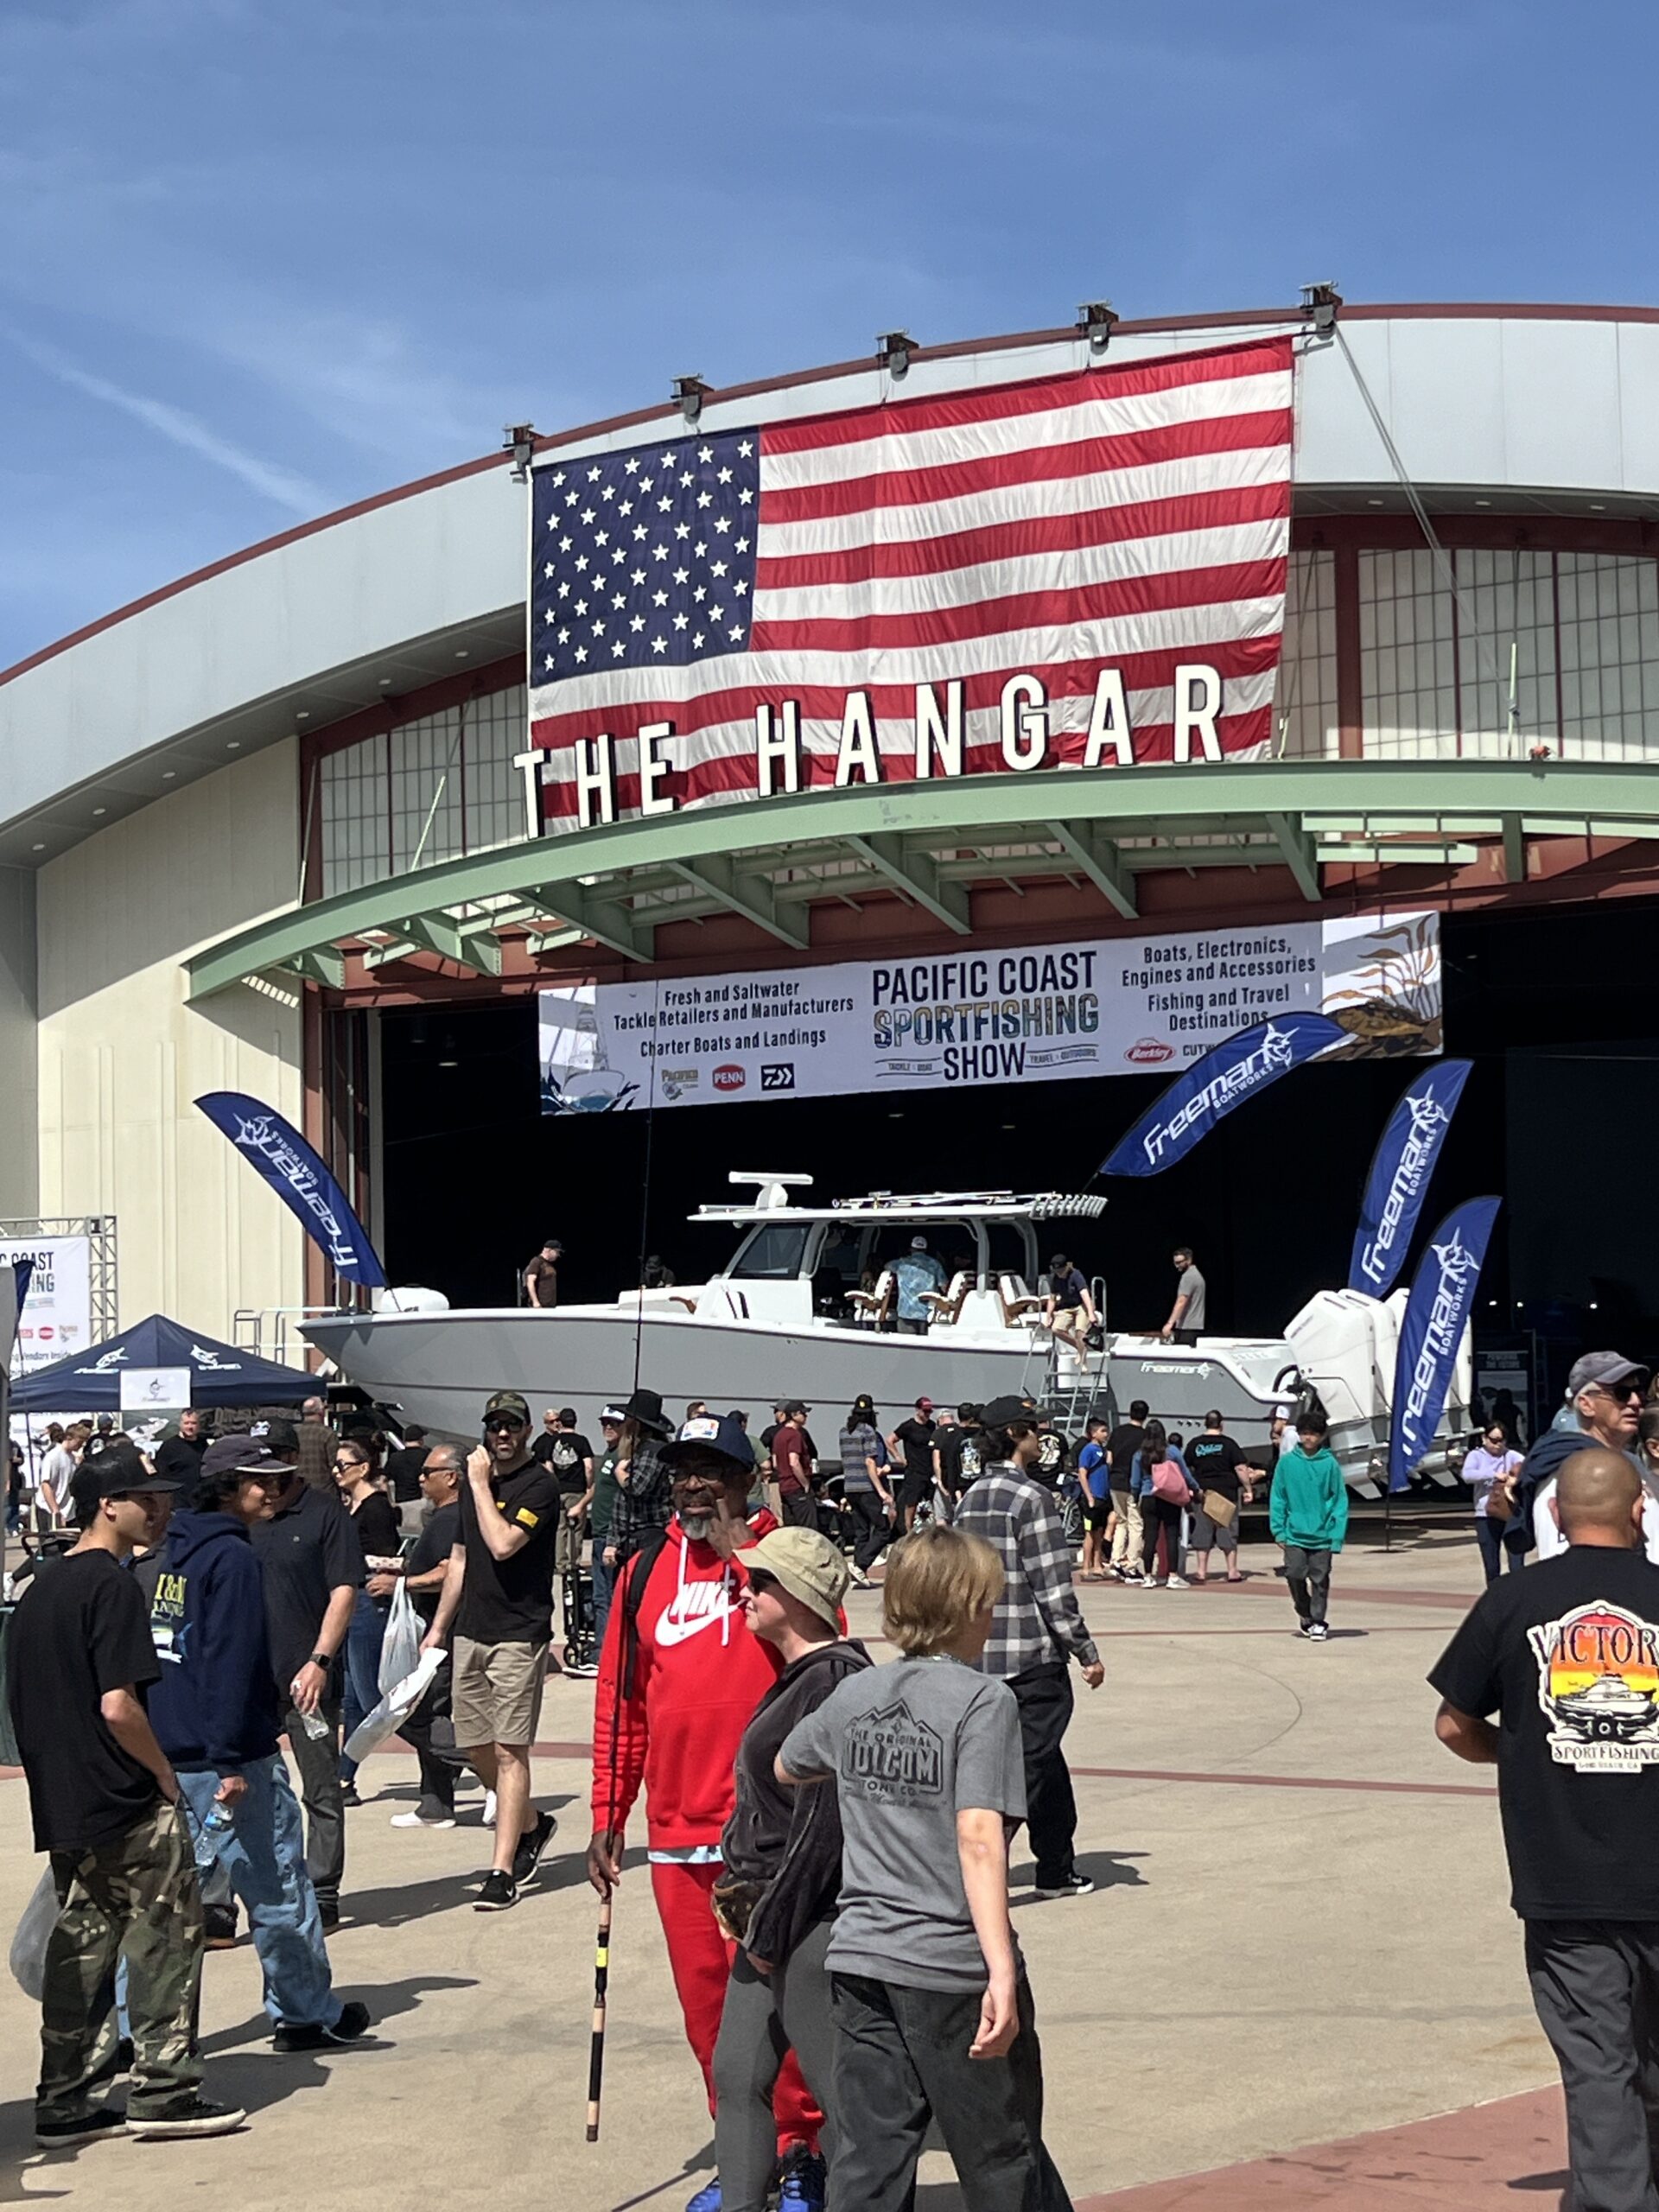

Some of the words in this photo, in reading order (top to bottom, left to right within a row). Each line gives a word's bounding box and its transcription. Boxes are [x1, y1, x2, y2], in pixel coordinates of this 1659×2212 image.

[513, 722, 679, 840] THE
[754, 664, 1224, 798] HANGAR
[1144, 945, 1192, 963] Boats,
[1197, 937, 1291, 959] Electronics,
[873, 960, 988, 1006] PACIFIC
[998, 950, 1097, 995] COAST
[1122, 967, 1182, 988] Engines
[1186, 963, 1214, 982] and
[1219, 956, 1316, 978] Accessories
[665, 988, 701, 1006] Fresh
[705, 985, 729, 1003] and
[733, 981, 799, 1001] Saltwater
[1148, 993, 1204, 1012] Fishing
[1209, 988, 1236, 1007] and
[1241, 983, 1289, 1004] Travel
[614, 1012, 656, 1030] Tackle
[659, 1007, 719, 1027] Retailers
[723, 1003, 747, 1021] and
[752, 997, 854, 1019] Manufacturers
[874, 993, 1099, 1048] SPORTFISHING
[1169, 1009, 1269, 1032] Destinations
[641, 1040, 690, 1057] Charter
[694, 1035, 731, 1052] Boats
[735, 1033, 760, 1049] and
[764, 1027, 826, 1047] Landings
[944, 1042, 1027, 1080] SHOW
[715, 1071, 743, 1084] PENN
[1213, 1063, 1274, 1109] BOATWORKS
[1408, 1128, 1438, 1196] BOATWORKS
[1439, 1276, 1467, 1355] BOATWORKS
[851, 1727, 869, 1742] THE
[1554, 1745, 1659, 1760] SPORTFISHING
